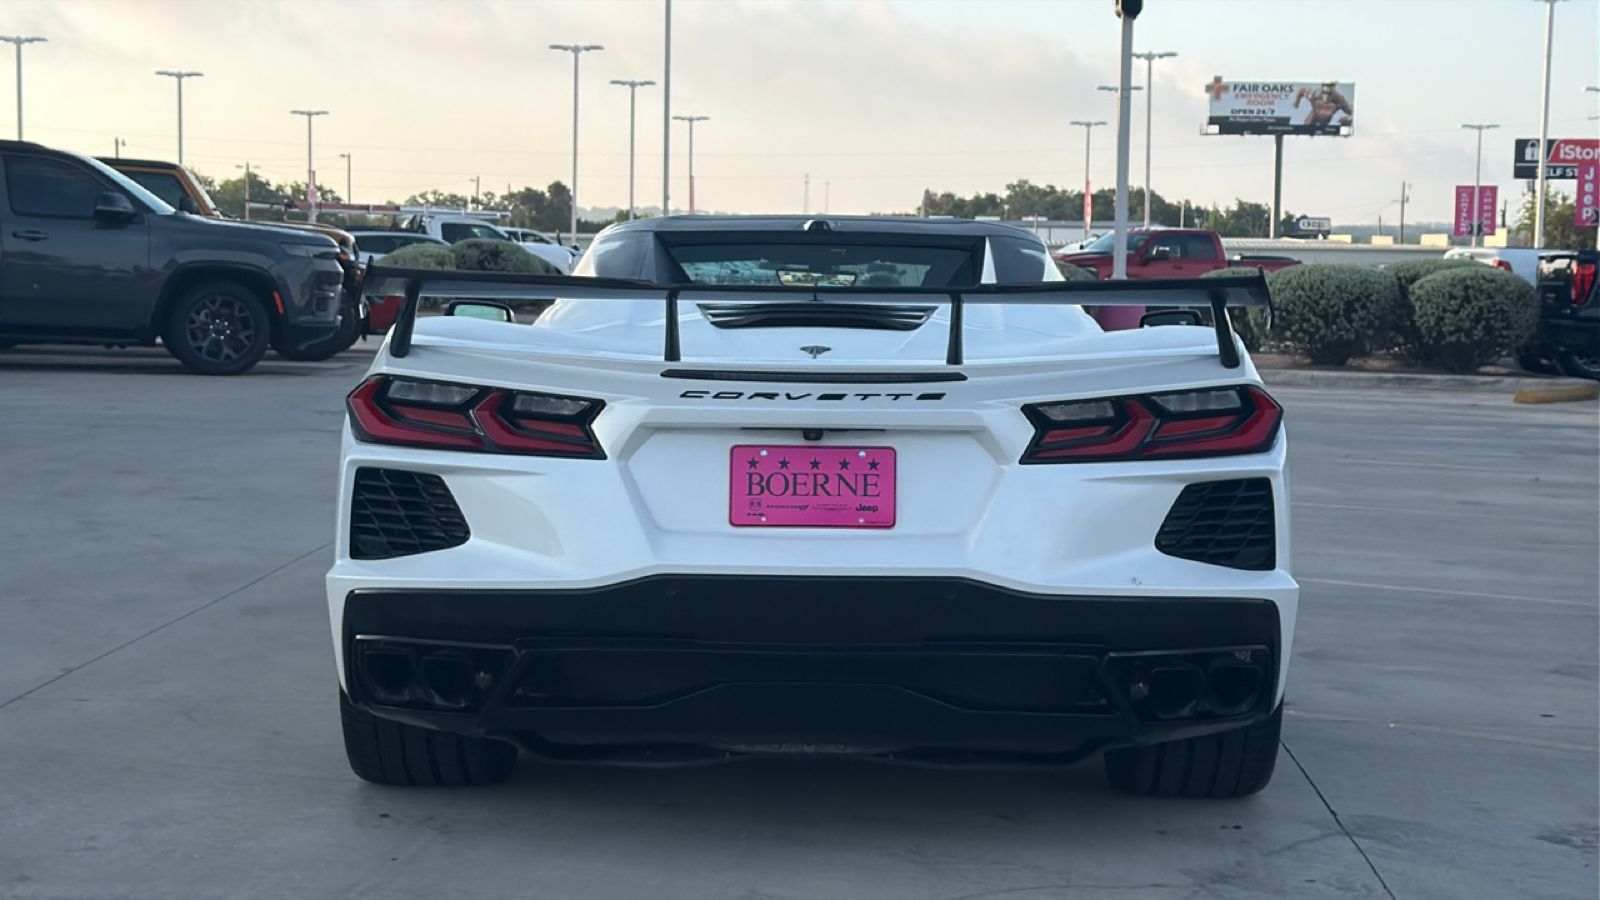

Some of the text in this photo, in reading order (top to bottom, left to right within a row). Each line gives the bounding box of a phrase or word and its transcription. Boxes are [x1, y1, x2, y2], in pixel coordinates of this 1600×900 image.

[1233, 84, 1295, 92] FAIR OAKS
[1581, 166, 1595, 221] Jeep
[679, 390, 946, 401] CORVETTE
[746, 472, 881, 497] BOERNE
[855, 503, 879, 513] Jeep
